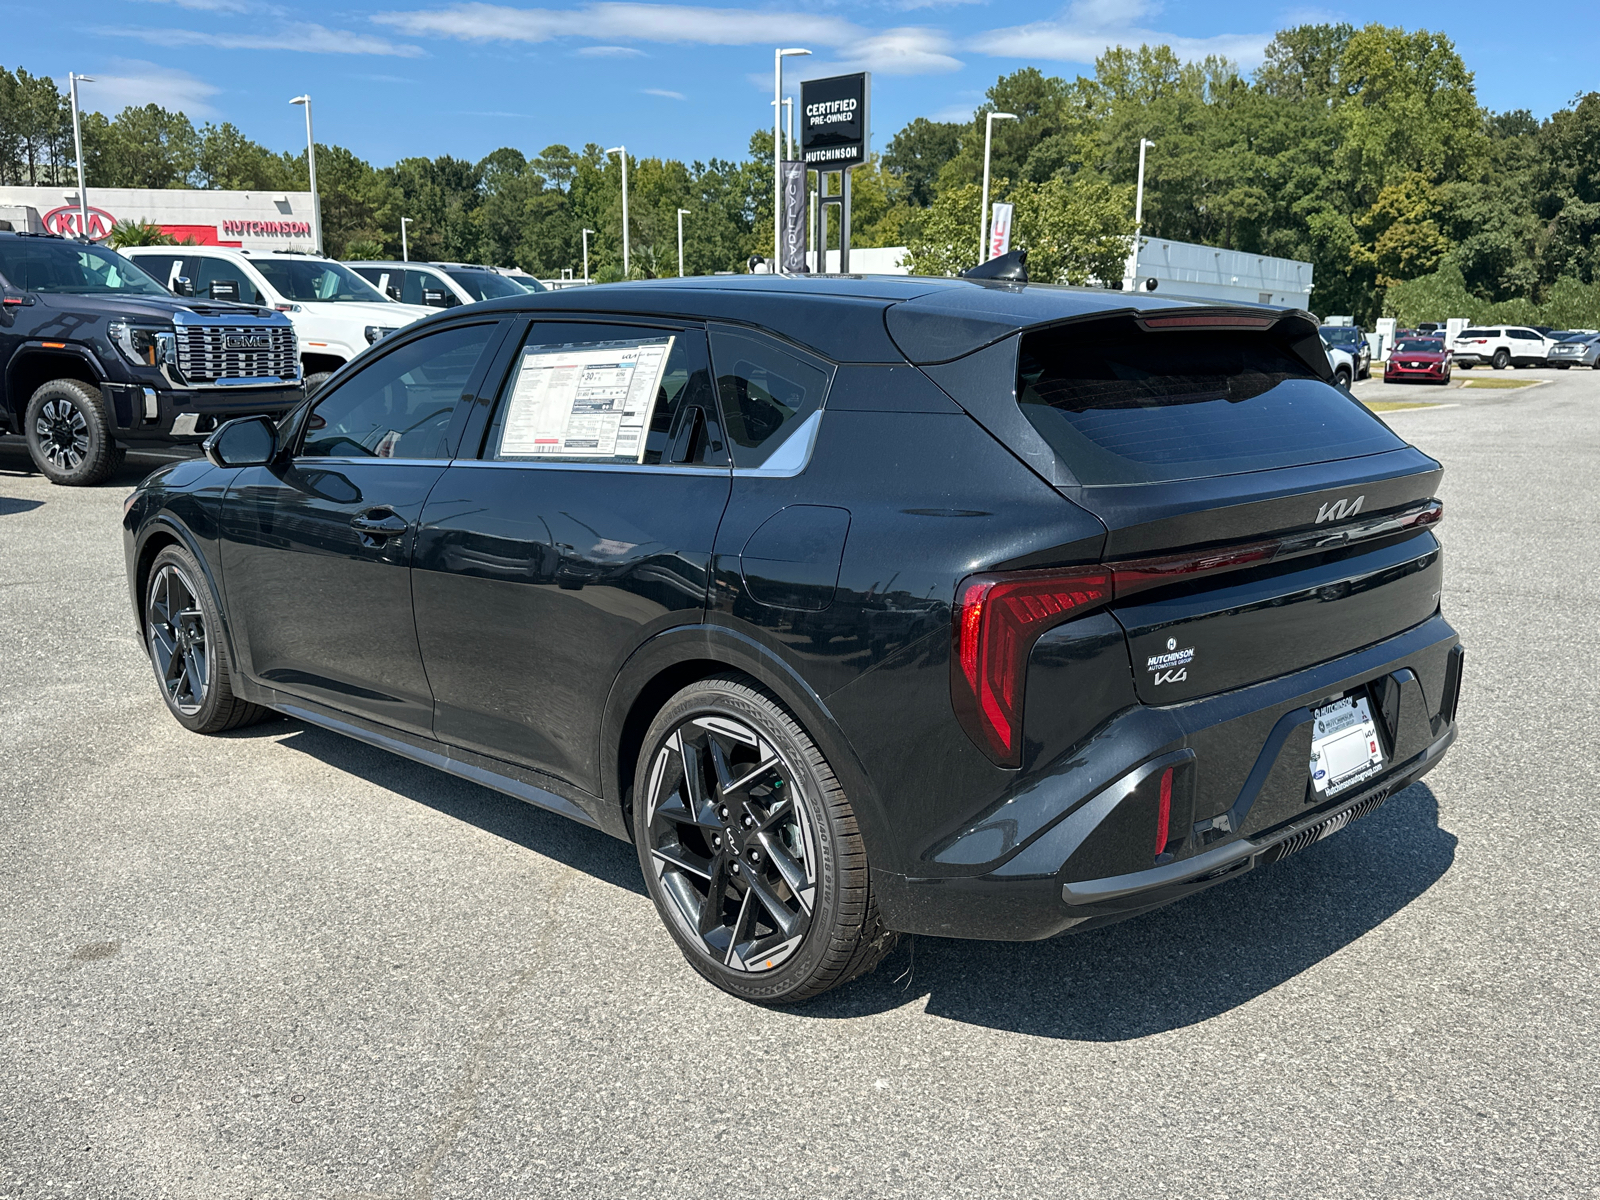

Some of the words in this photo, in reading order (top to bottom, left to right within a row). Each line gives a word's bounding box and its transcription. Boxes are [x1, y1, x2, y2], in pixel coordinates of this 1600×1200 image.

[806, 98, 857, 116] CERTIFIED
[810, 112, 852, 126] PRE-OWNED
[806, 147, 857, 163] HUTCHINSON
[55, 214, 106, 236] KIA
[223, 220, 309, 233] HUTCHINSON
[227, 336, 270, 347] GMC
[585, 372, 594, 380] 30
[1315, 495, 1365, 524] KIA
[1148, 648, 1195, 666] HUTCHINSON
[1148, 661, 1177, 671] AUTOMOTIVE
[1178, 657, 1192, 665] GROUP
[1155, 667, 1187, 685] K4
[1320, 696, 1353, 717] HUTCHINSON
[810, 798, 828, 841] 235/40
[823, 846, 832, 871] R18
[823, 873, 833, 904] 91W
